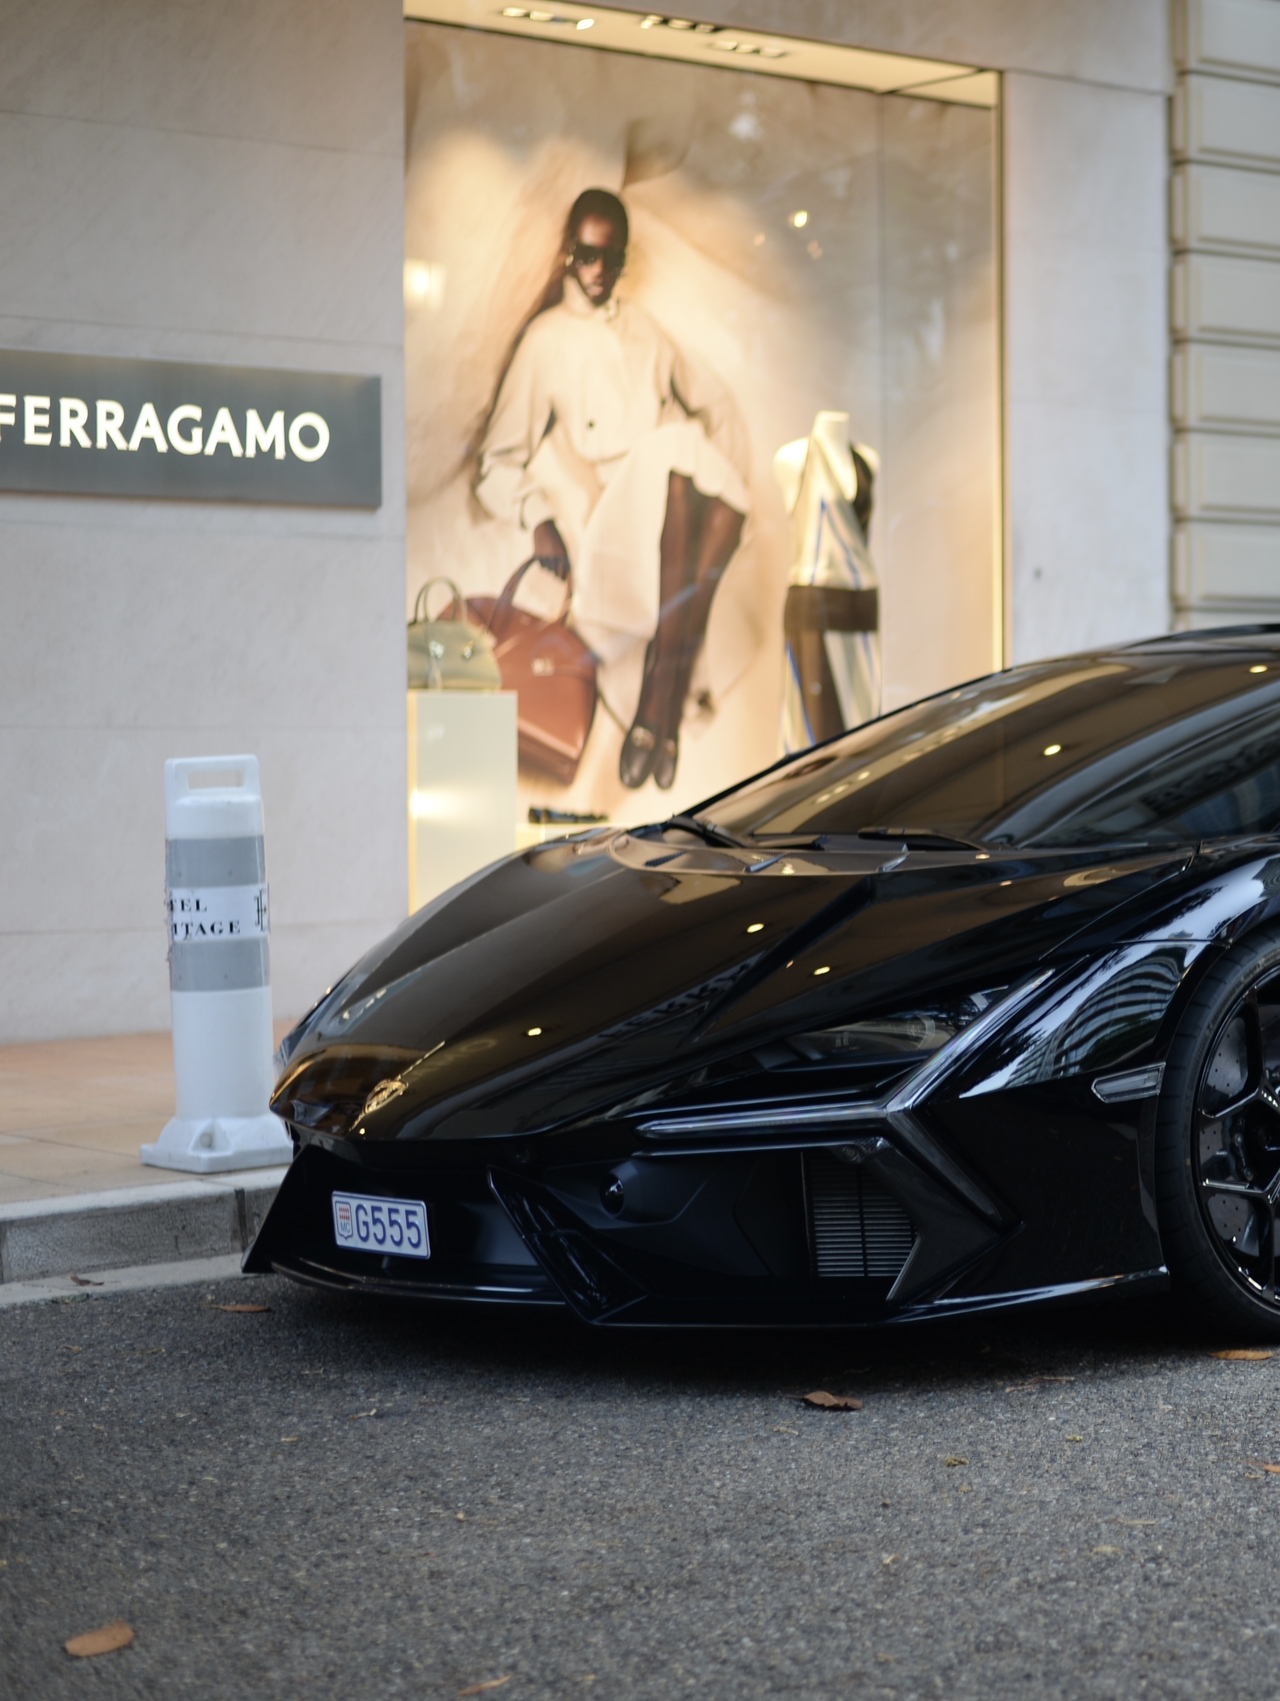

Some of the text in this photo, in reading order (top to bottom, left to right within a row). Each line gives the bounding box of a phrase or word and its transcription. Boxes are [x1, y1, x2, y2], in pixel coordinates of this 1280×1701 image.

[0, 393, 331, 463] FERRAGAMO
[340, 1221, 351, 1233] MC
[354, 1203, 422, 1249] G555
